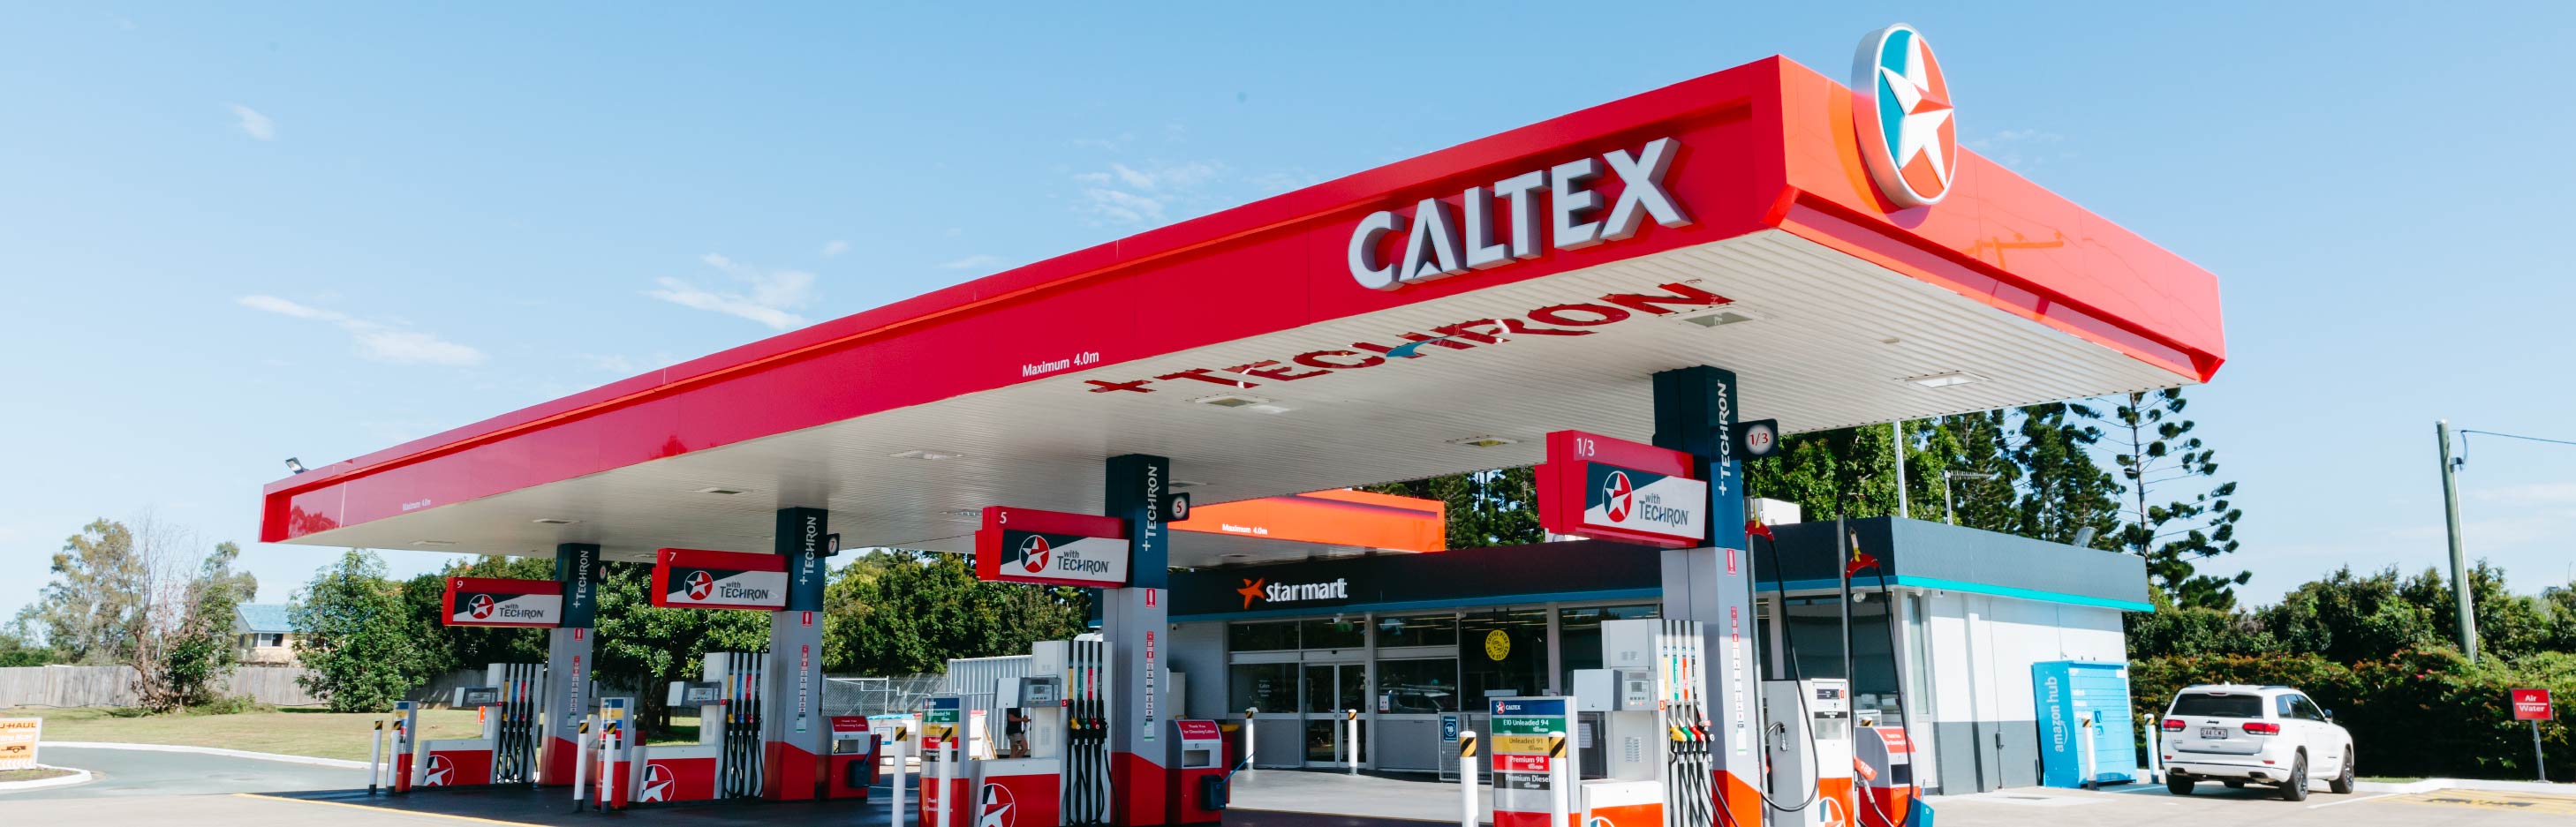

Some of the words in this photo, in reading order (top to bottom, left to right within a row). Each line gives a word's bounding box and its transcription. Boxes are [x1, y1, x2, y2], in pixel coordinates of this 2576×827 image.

[1348, 137, 1694, 291] CALTEX
[1023, 358, 1069, 377] Maximum
[1074, 351, 1099, 366] 4.0m
[1576, 437, 1595, 457] 1/3
[1749, 432, 1769, 447] 1/3
[1645, 492, 1660, 505] with
[1176, 500, 1182, 514] 5
[1638, 500, 1688, 527] TECHRON
[1000, 511, 1008, 524] 5
[1222, 523, 1251, 533] Maximum
[1252, 526, 1268, 535] 4.0m
[669, 552, 676, 562] 7
[1063, 550, 1079, 559] with
[1057, 555, 1109, 575] TECHRON
[457, 580, 464, 589] 9
[720, 586, 768, 601] TECHRON
[499, 607, 544, 619] TECHRON
[2044, 676, 2059, 703] hub
[2051, 705, 2065, 753] amazon
